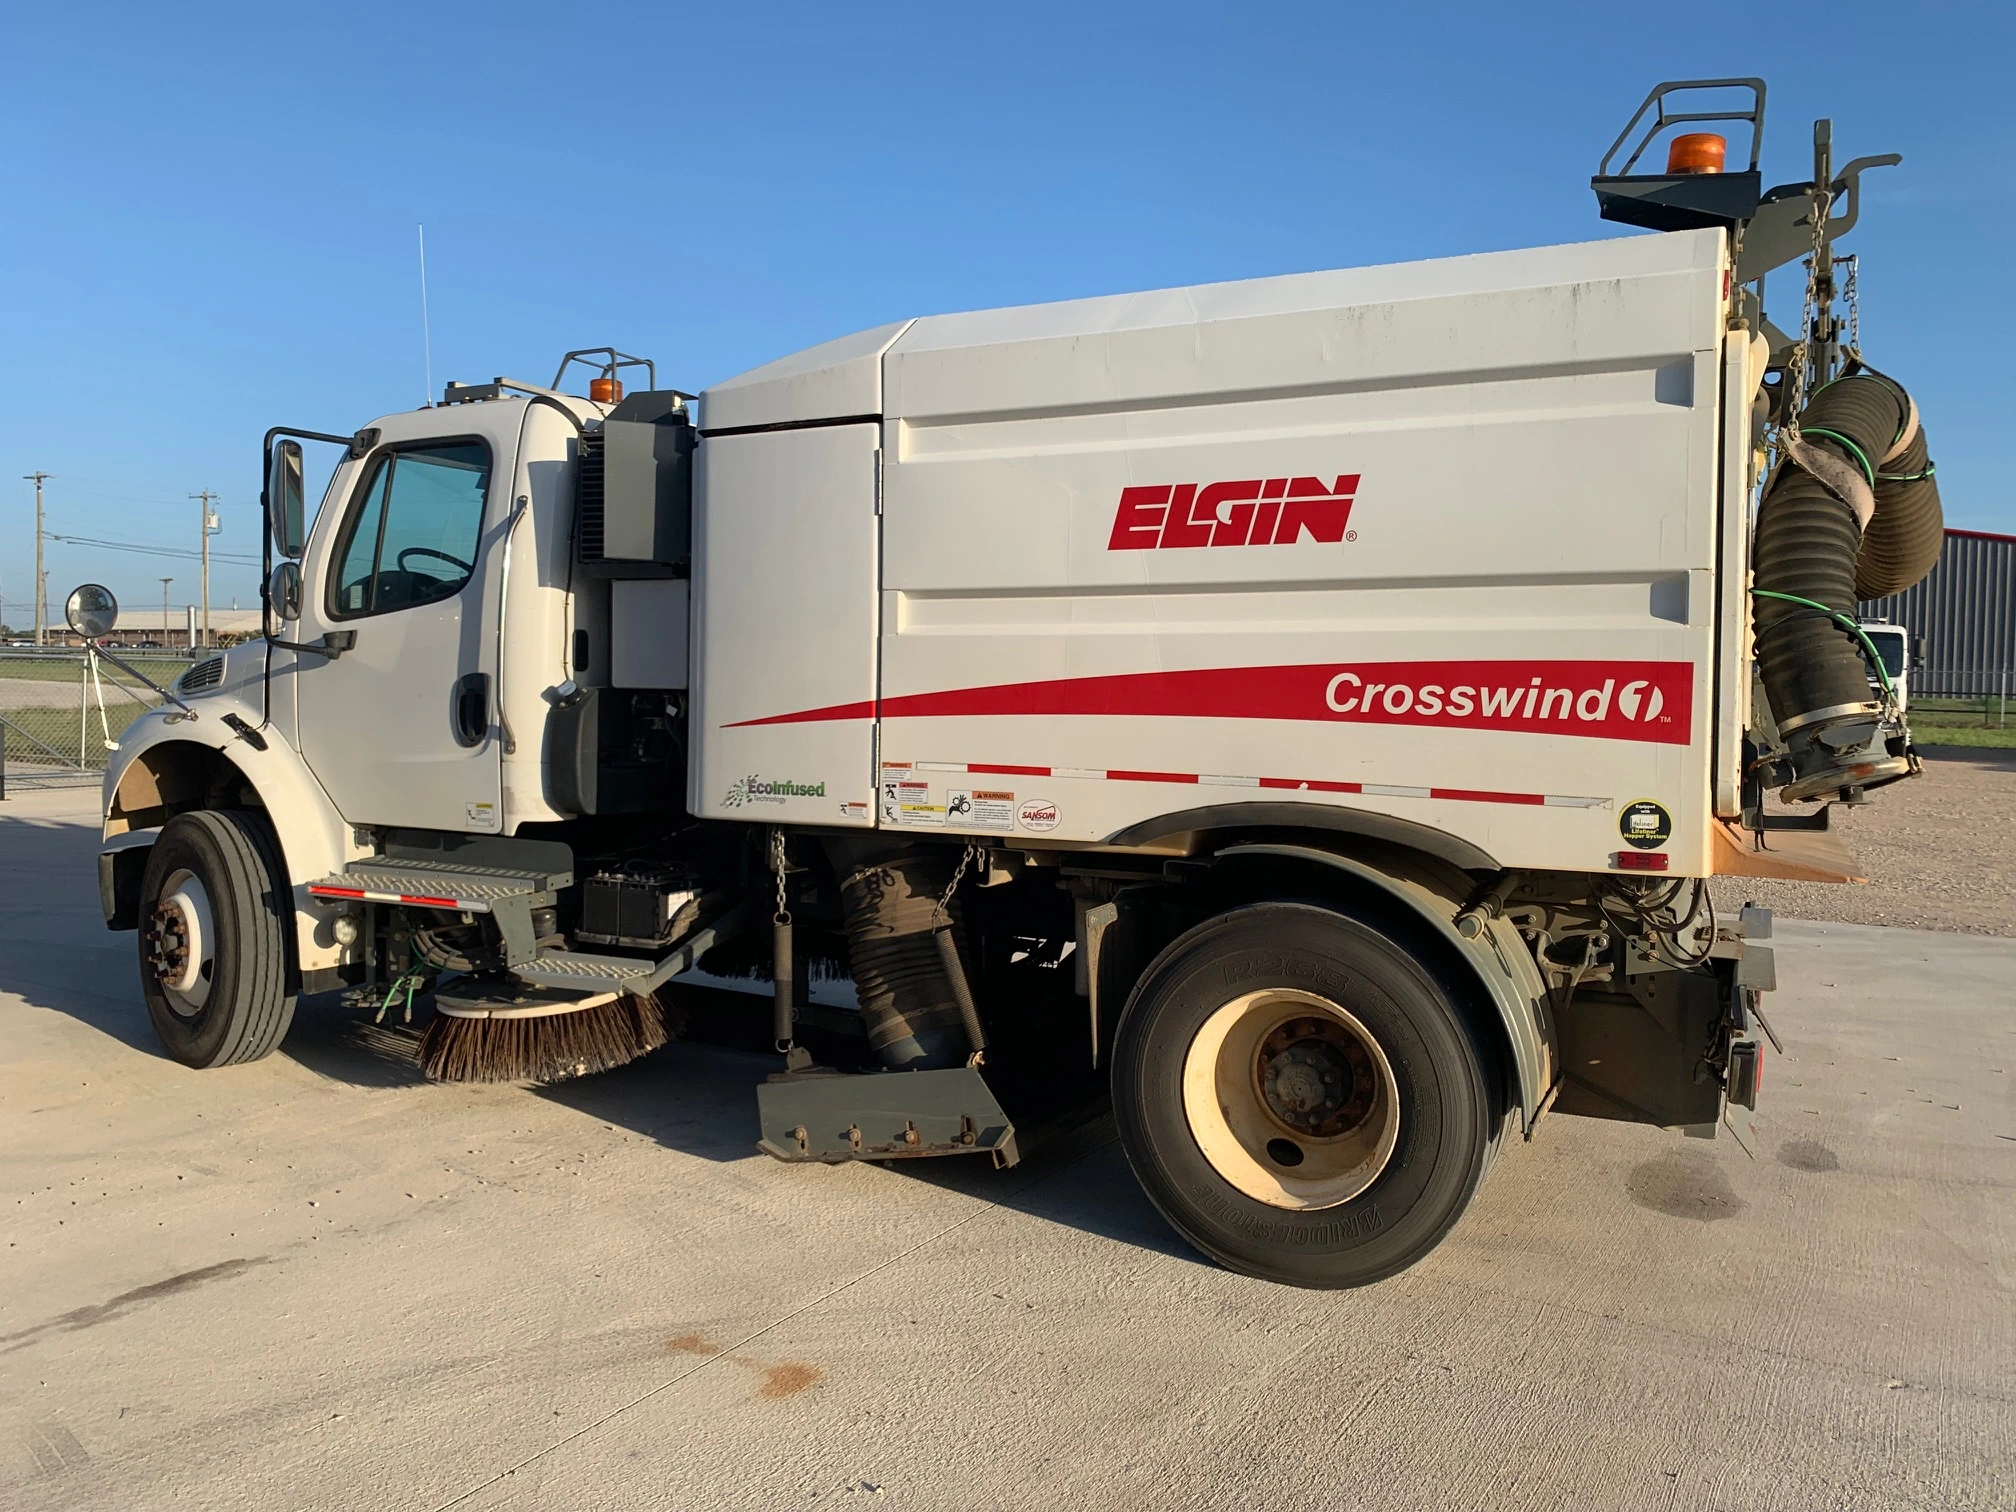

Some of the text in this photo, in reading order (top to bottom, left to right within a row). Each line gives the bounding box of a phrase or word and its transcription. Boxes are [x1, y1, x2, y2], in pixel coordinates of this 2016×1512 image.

[1108, 474, 1361, 550] ELGIN
[1325, 672, 1616, 721] Crosswind
[753, 795, 787, 804] Technology
[1022, 811, 1056, 821] SANSOM
[1189, 1183, 1385, 1247] BRIDGESTONE
